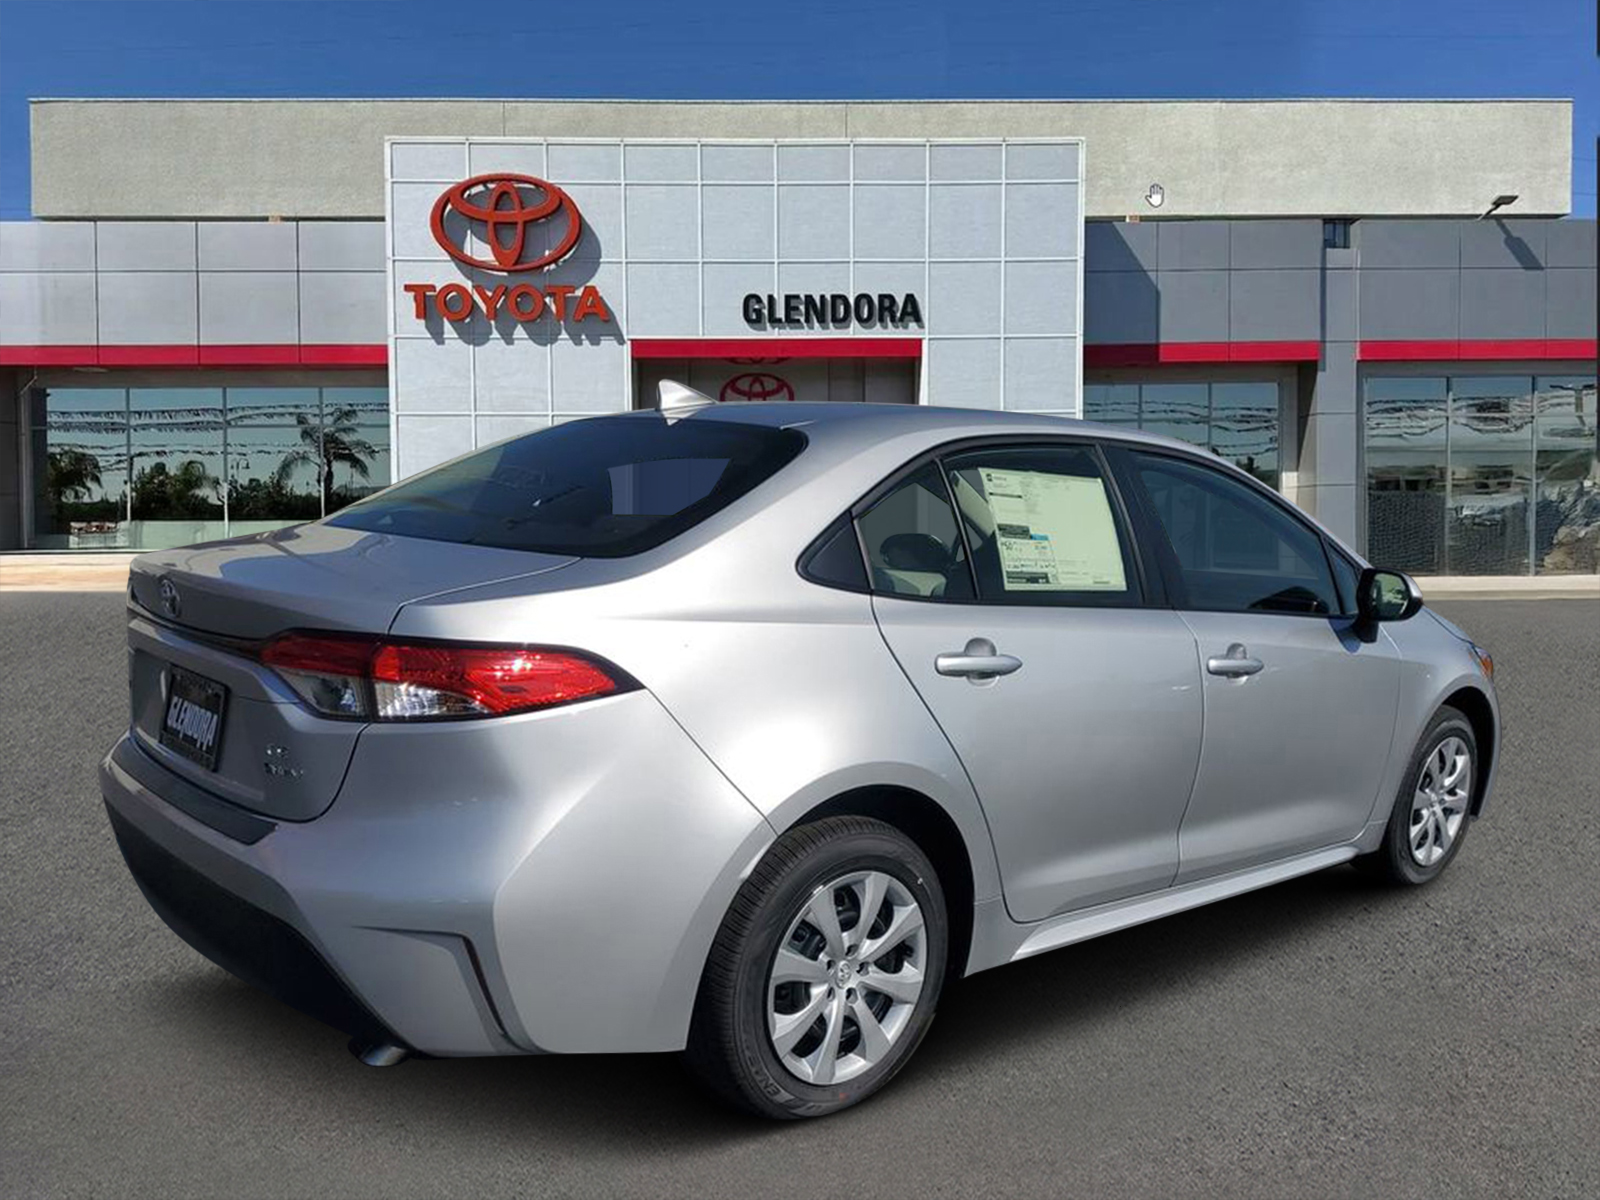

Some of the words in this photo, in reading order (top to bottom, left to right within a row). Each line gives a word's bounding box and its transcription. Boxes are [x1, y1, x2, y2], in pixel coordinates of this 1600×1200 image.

[404, 283, 610, 322] TOYOTA
[743, 293, 922, 325] GLENDORA
[167, 696, 218, 751] GLENDORA
